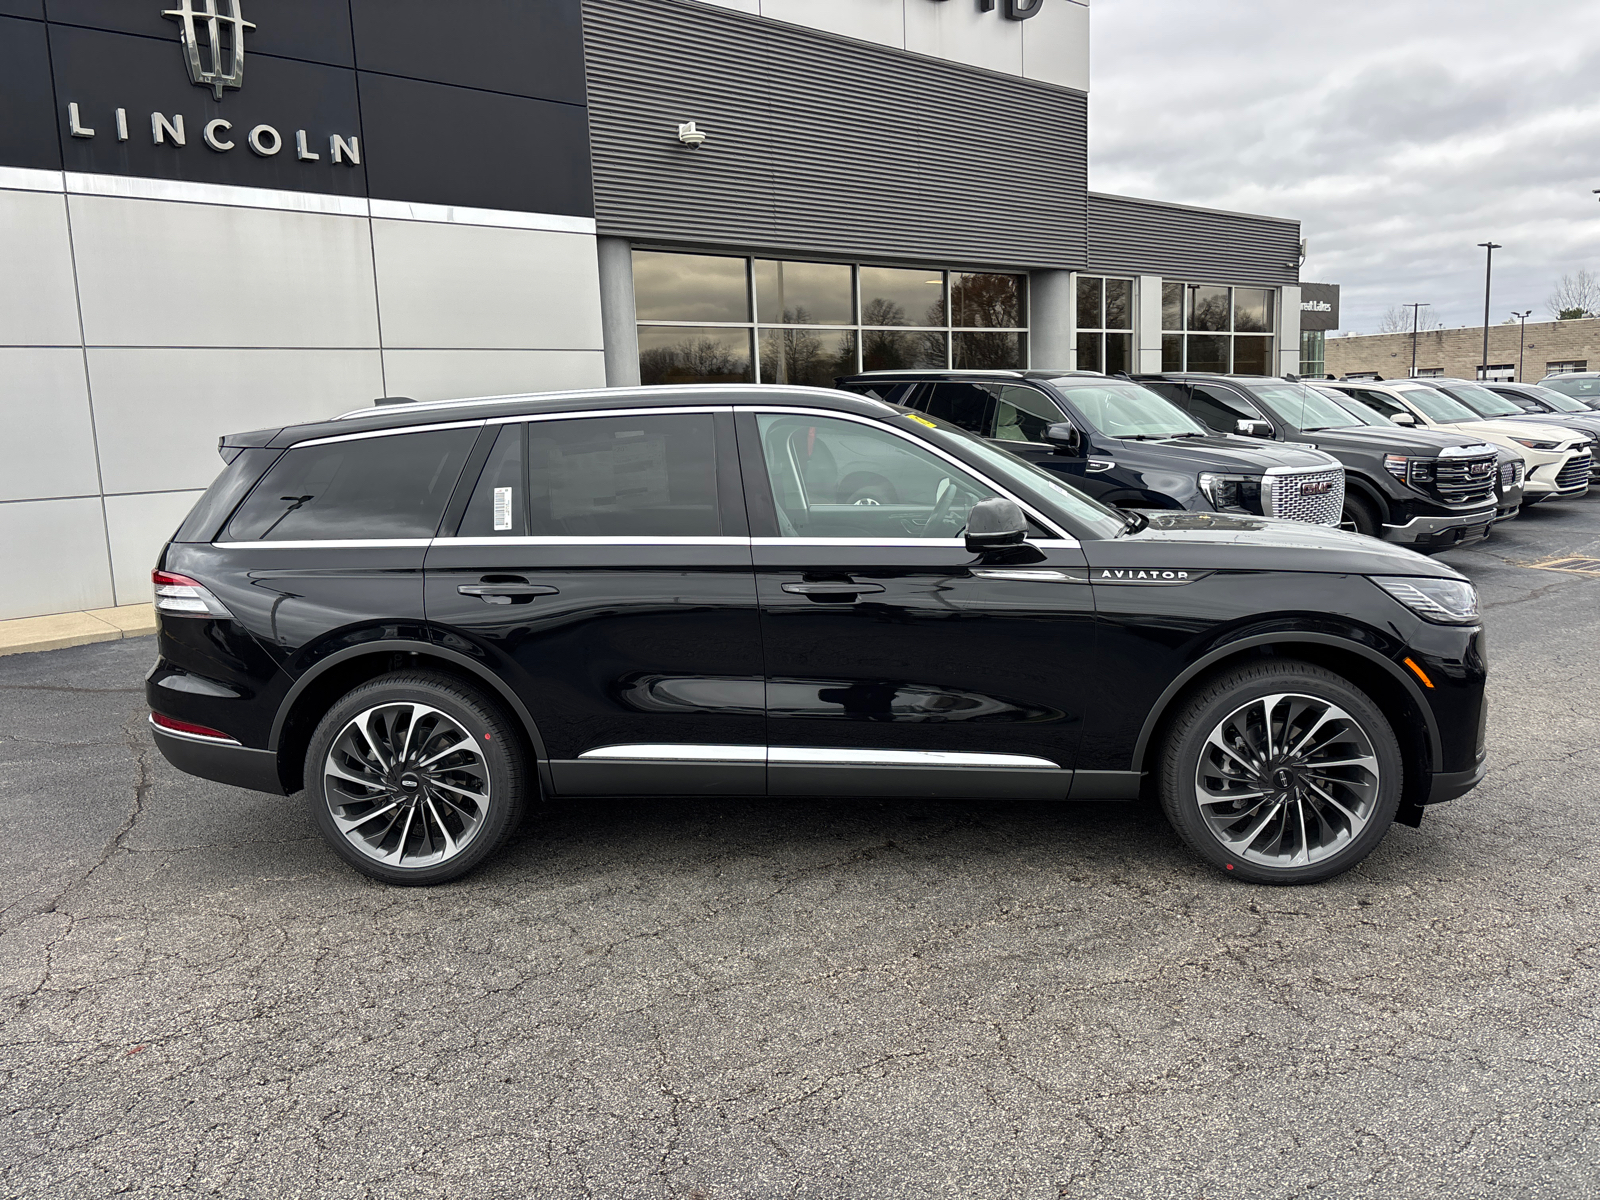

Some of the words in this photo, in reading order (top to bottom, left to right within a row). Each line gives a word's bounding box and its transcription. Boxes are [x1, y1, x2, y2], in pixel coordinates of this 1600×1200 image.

[68, 102, 360, 165] LINCOLN
[1299, 301, 1313, 311] reat
[1314, 300, 1331, 311] Lakes
[1302, 482, 1333, 495] GMC
[1101, 570, 1188, 579] AVIATOR
